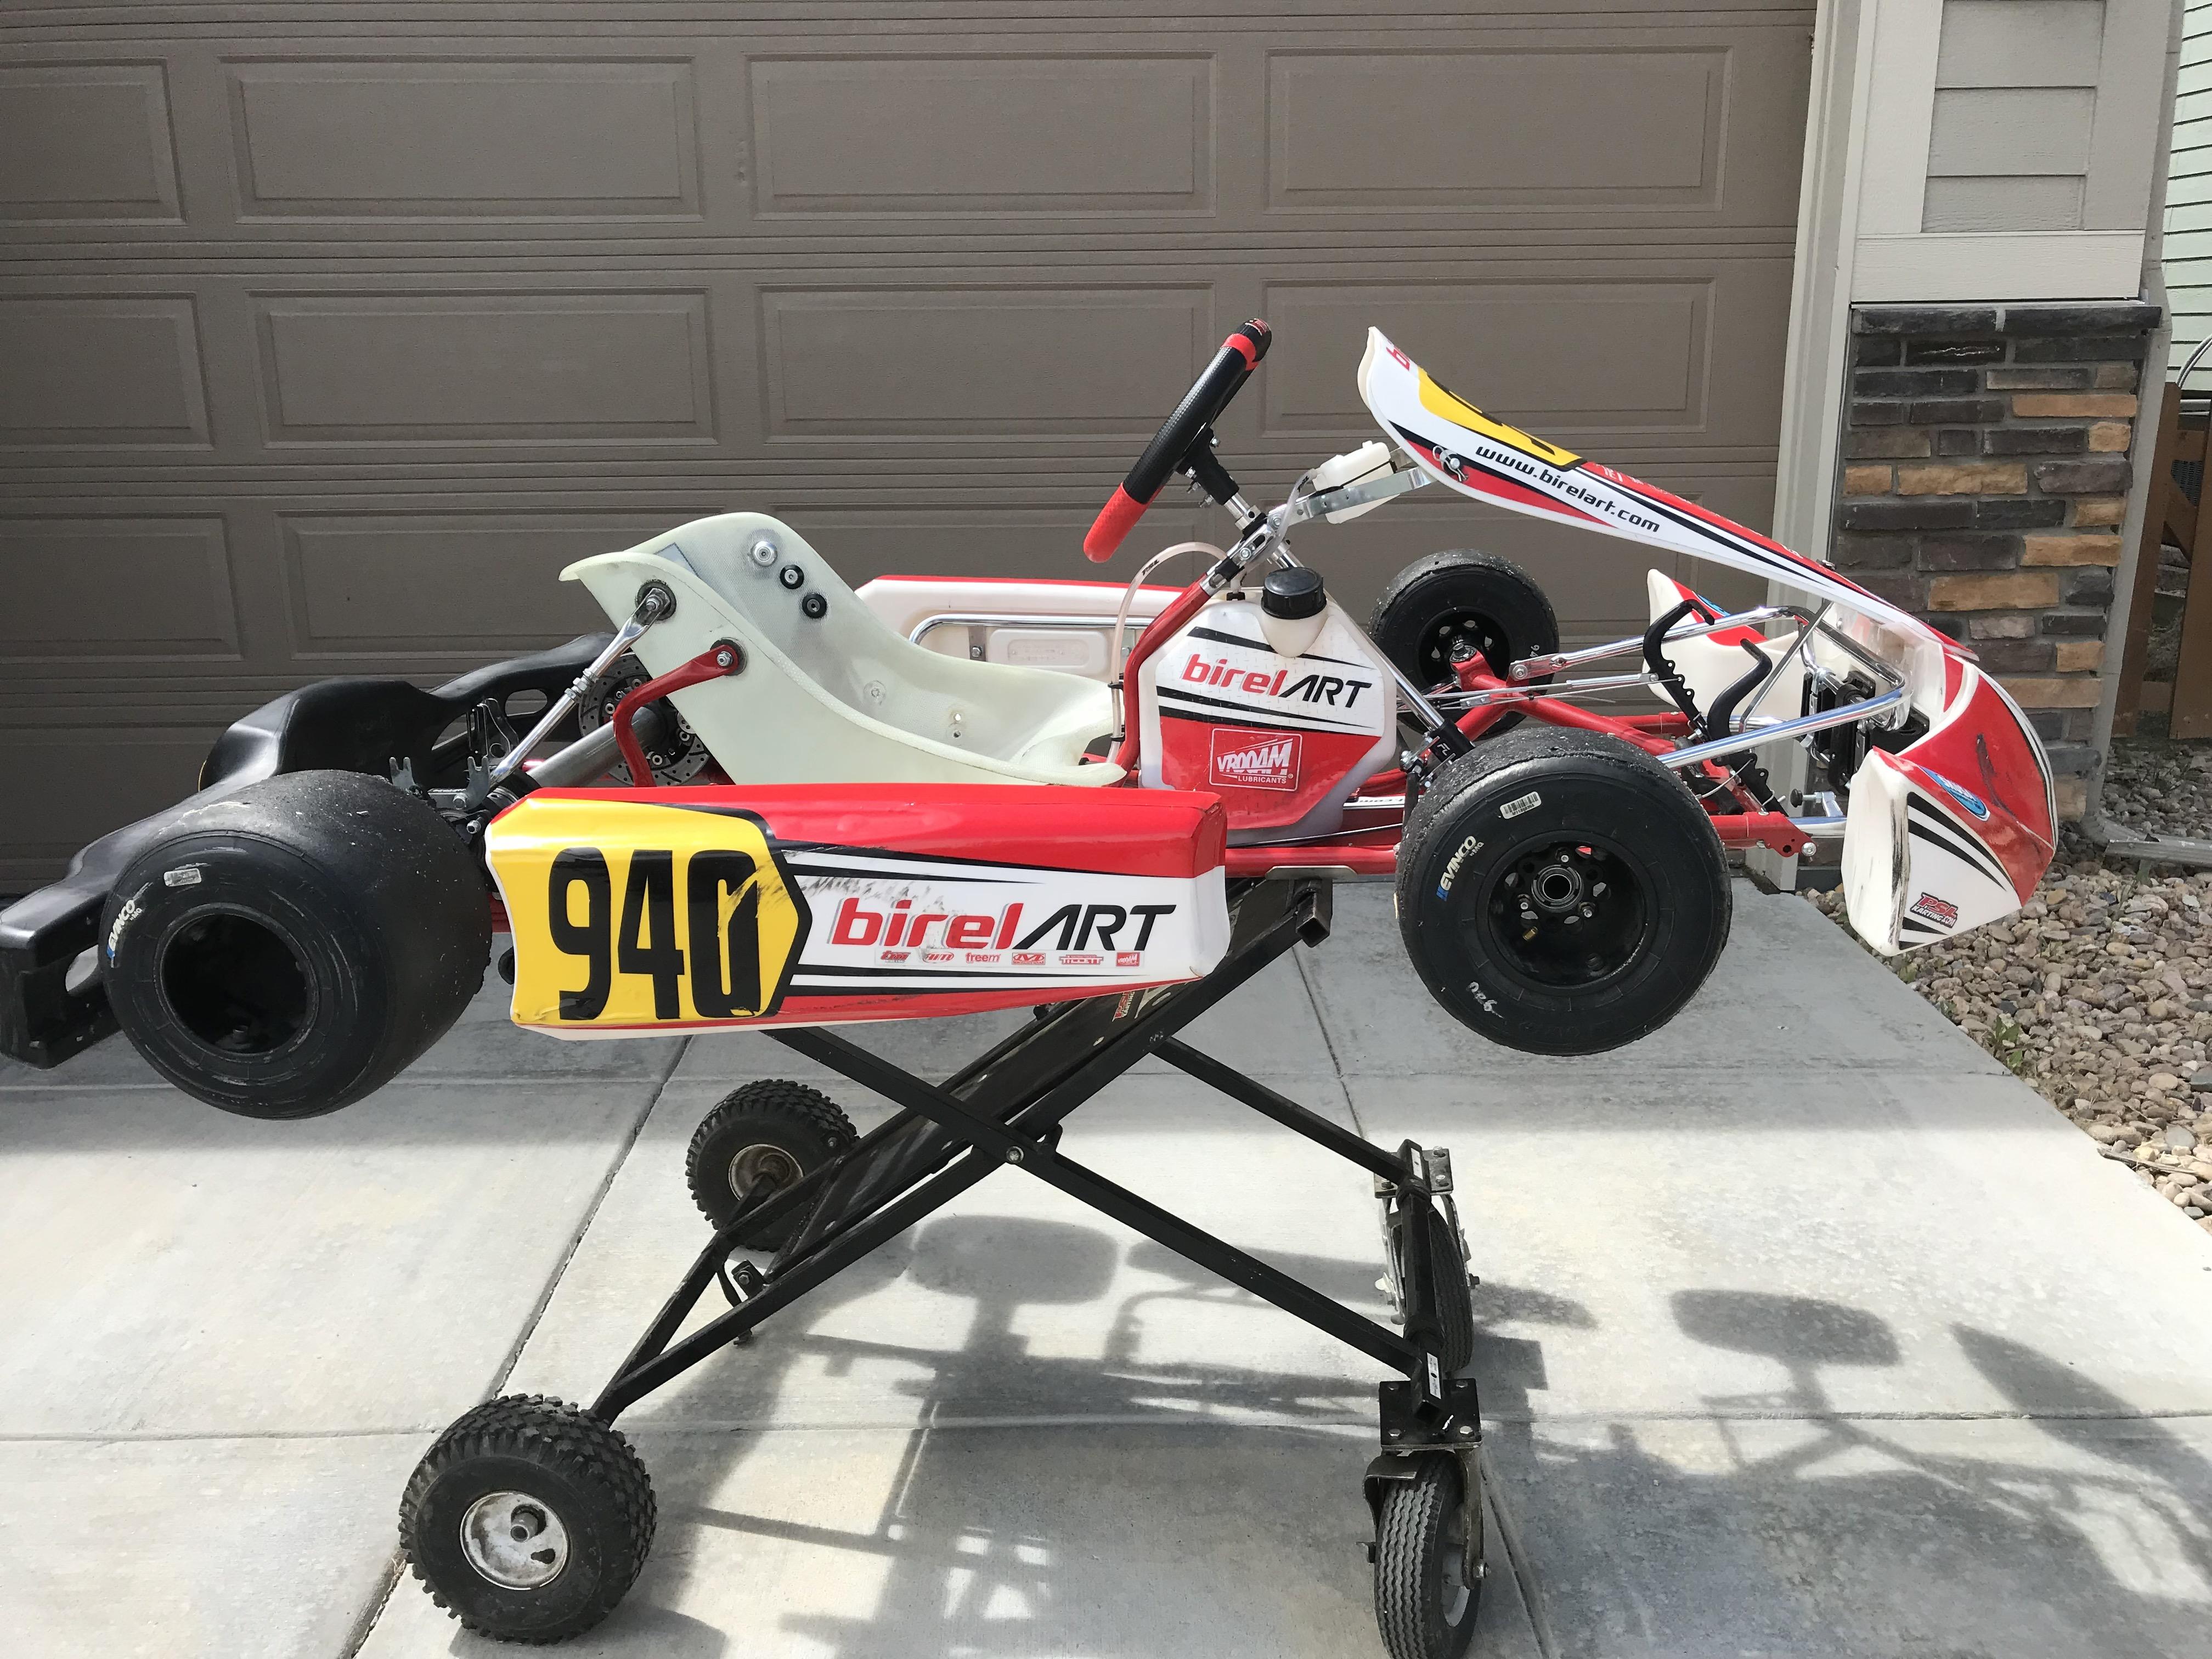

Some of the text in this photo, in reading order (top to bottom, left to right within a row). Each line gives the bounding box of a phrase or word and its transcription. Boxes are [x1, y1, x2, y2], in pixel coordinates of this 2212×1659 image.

[1476, 445, 1660, 532] www.birelart.com
[1180, 653, 1373, 708] birelART
[1217, 741, 1293, 775] VROOAM
[1238, 775, 1287, 785] LUBRICANTS
[1440, 836, 1476, 891] EVINCO
[108, 900, 136, 951] EVINCO
[826, 898, 1177, 950] birelART
[1917, 894, 1957, 918] PSL
[549, 847, 761, 1020] 940
[966, 952, 1000, 963] freem
